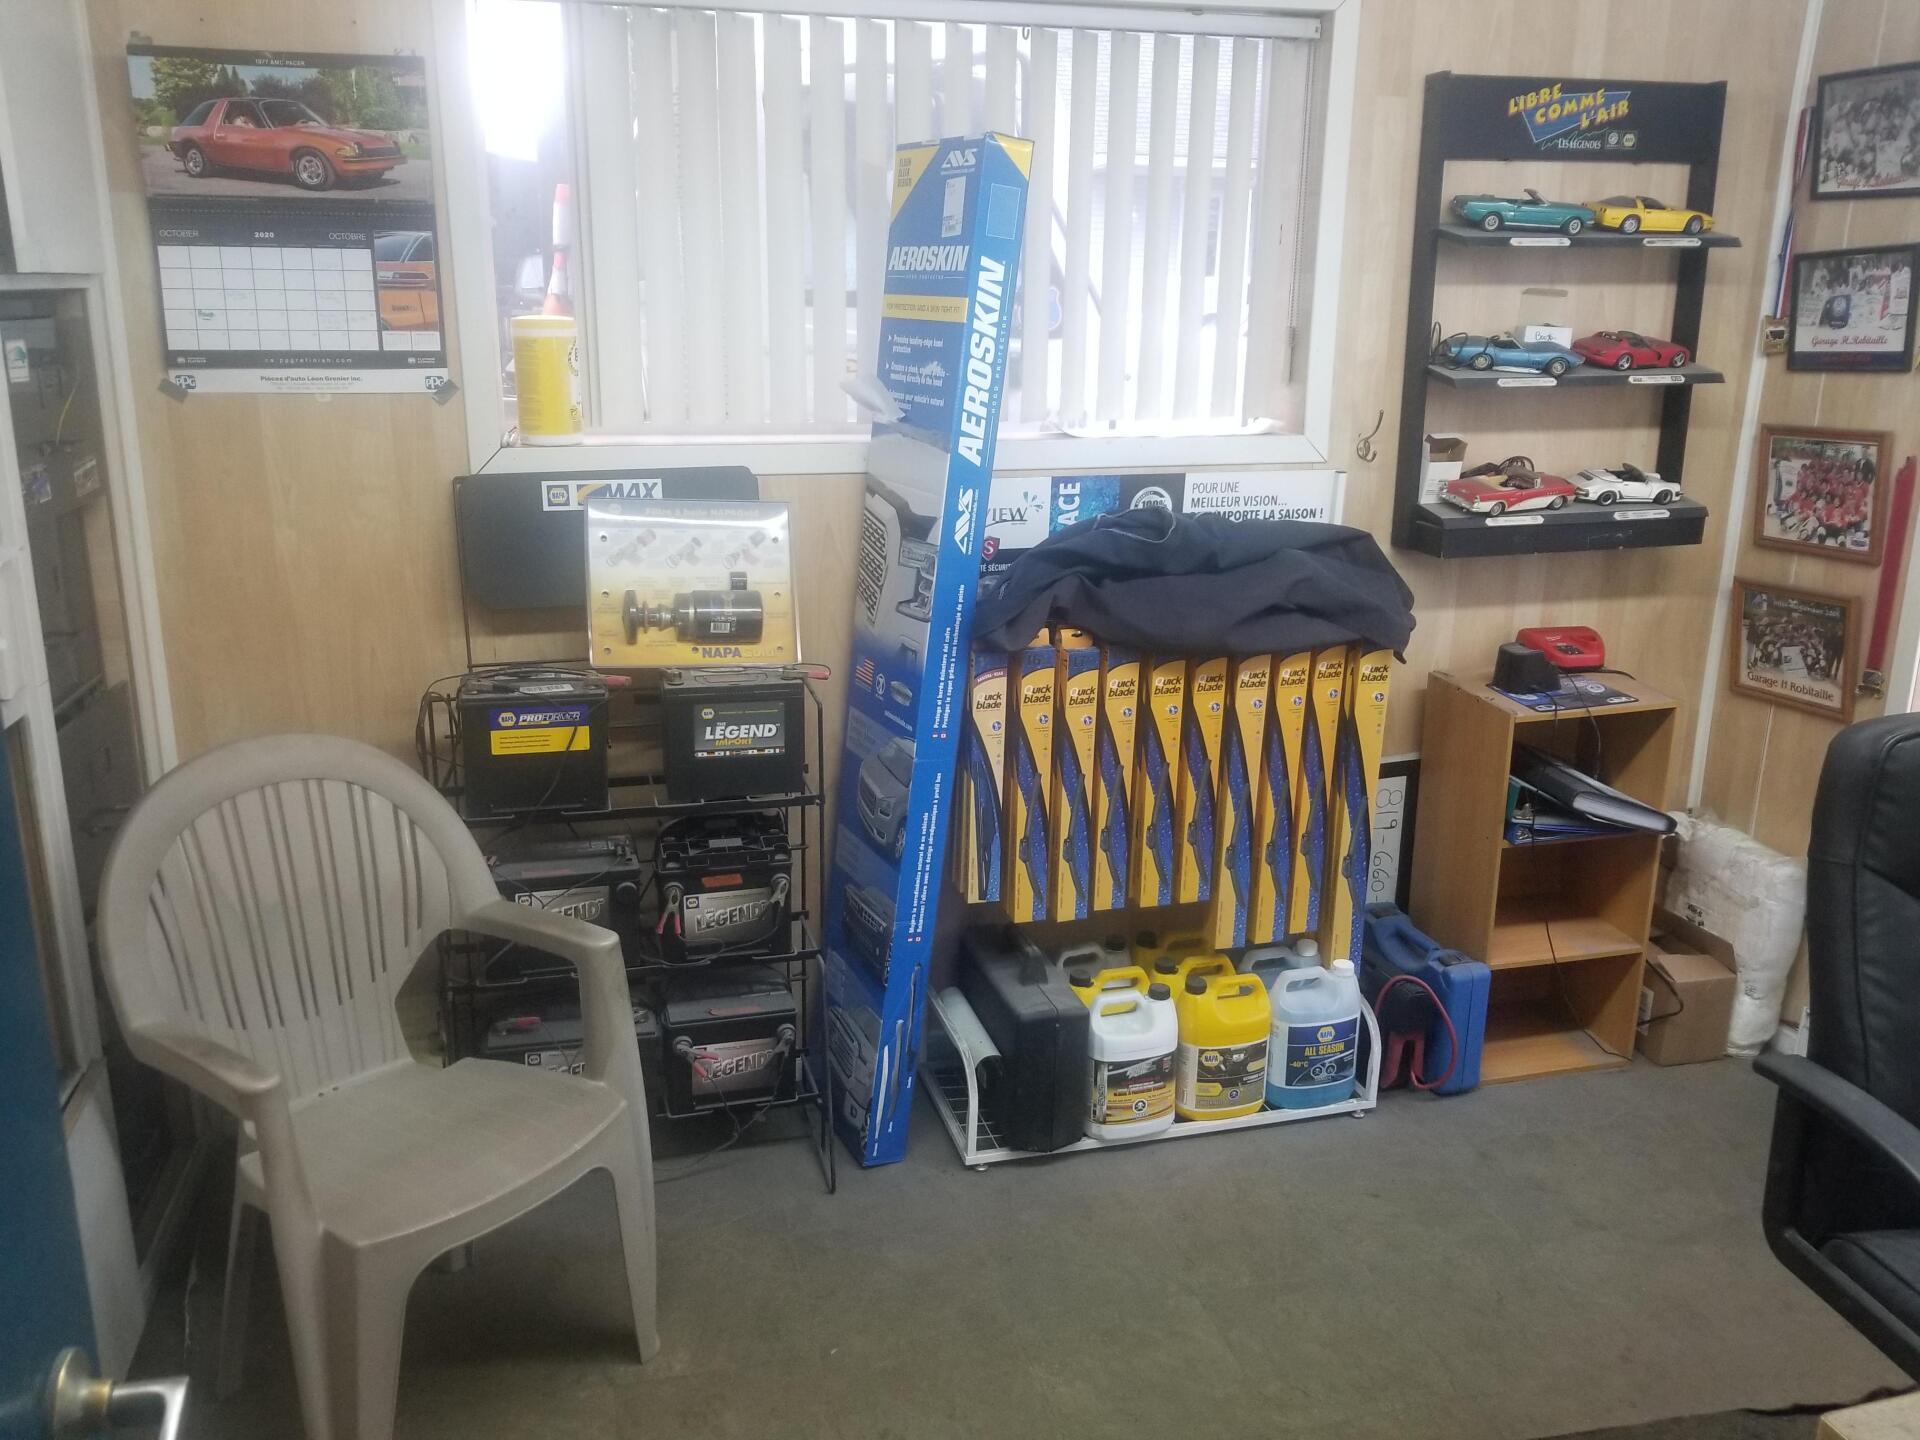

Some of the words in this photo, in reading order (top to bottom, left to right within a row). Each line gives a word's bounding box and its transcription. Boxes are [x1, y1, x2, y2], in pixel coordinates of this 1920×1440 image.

[1508, 82, 1562, 116] LIBRE
[1534, 87, 1606, 125] COMME
[1579, 99, 1630, 130] L'AIR
[254, 231, 275, 239] 2020
[328, 231, 367, 241] OCTOBRE
[888, 245, 969, 272] AEROSKIN
[958, 256, 1006, 467] AEROSKIN
[176, 376, 195, 389] PPG
[1192, 482, 1218, 494] POUR
[1220, 482, 1240, 494] UNE
[1057, 481, 1082, 526] ACE
[1191, 497, 1242, 509] MEILLEUR
[989, 507, 1028, 521] IEW
[1219, 509, 1261, 521] MPORTE
[1263, 508, 1276, 521] LA
[1278, 507, 1318, 520] SAISON
[1280, 676, 1306, 686] blade
[1317, 670, 1342, 680] blade
[1361, 673, 1388, 682] blade
[1154, 685, 1181, 694] blade
[1197, 682, 1223, 692] blade
[1240, 679, 1266, 688] blade
[1747, 671, 1778, 688] Garage
[1790, 682, 1834, 702] Robitaille
[1108, 687, 1135, 697] blade
[976, 700, 1002, 710] blade
[1023, 694, 1051, 704] blade
[1069, 696, 1095, 706] blade
[704, 723, 778, 740] LEGEND
[715, 738, 753, 747] IMPORT
[695, 901, 773, 933] LEGEND
[1305, 1046, 1317, 1057] ALL
[1319, 1042, 1345, 1055] SEASON
[1204, 1054, 1219, 1063] NAPA
